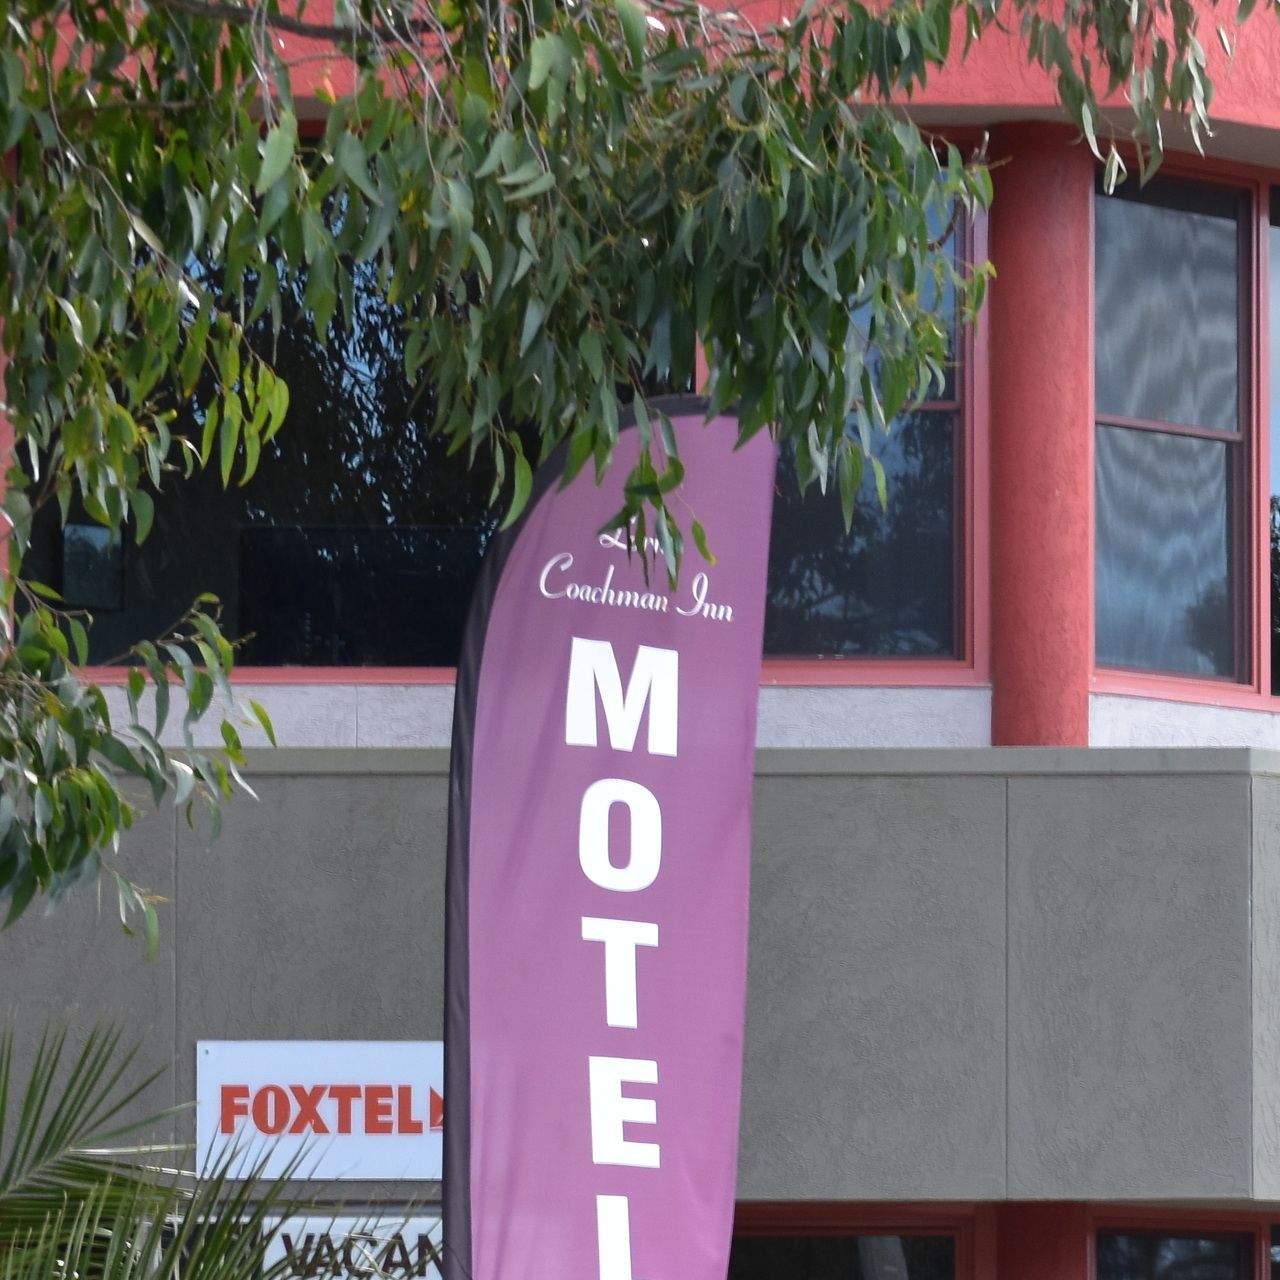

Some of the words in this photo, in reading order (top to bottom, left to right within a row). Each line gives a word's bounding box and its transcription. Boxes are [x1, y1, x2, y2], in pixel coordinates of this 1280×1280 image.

[599, 515, 684, 555] Lrn
[540, 553, 669, 613] Coachman
[676, 572, 735, 623] Inn
[219, 1083, 424, 1135] FOXTEL
